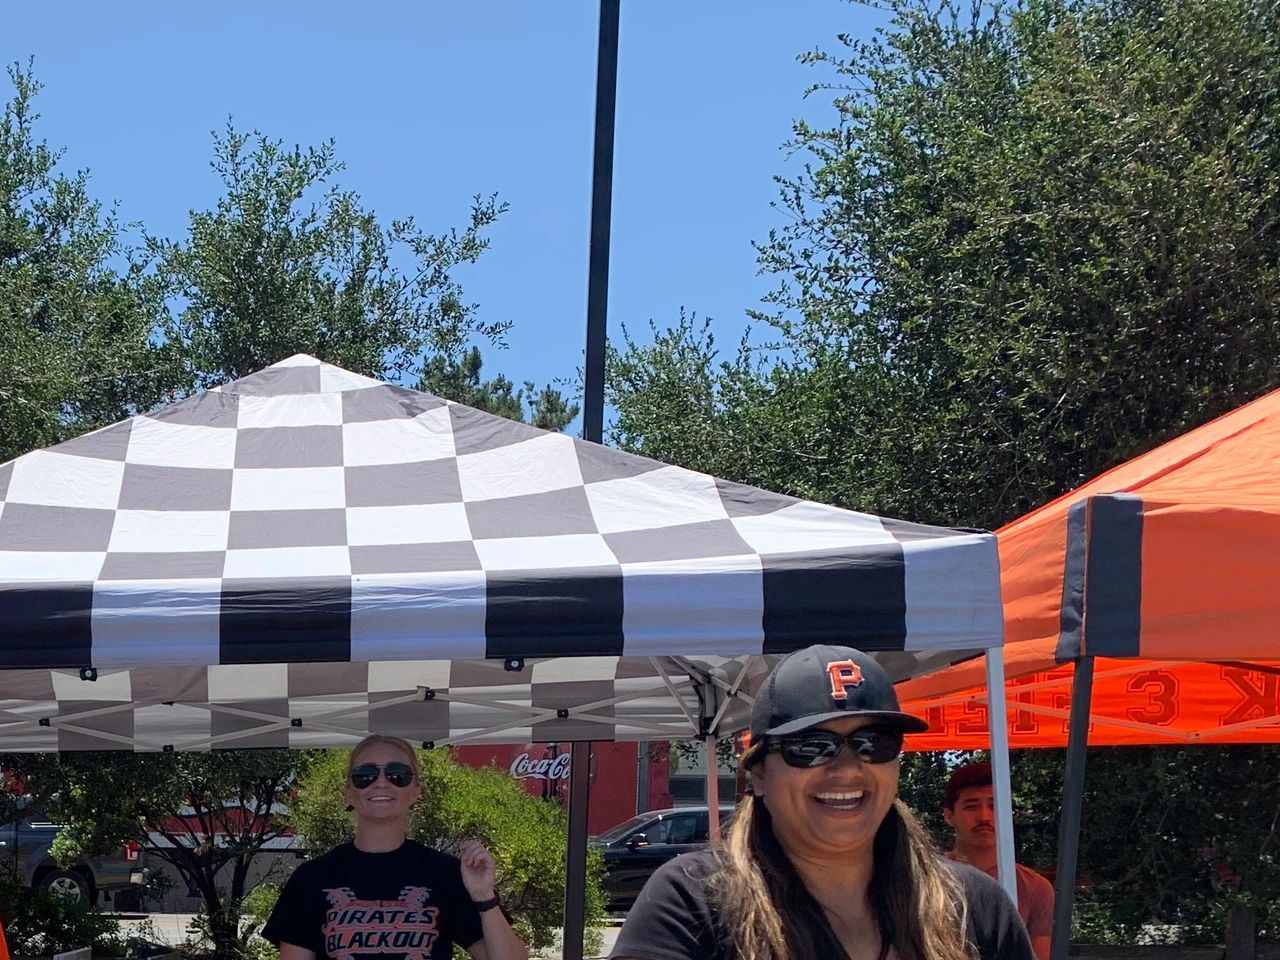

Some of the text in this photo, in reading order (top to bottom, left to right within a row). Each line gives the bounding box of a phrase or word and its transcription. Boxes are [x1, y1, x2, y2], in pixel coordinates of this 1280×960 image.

[826, 658, 866, 700] P
[328, 909, 435, 925] PIRATES
[327, 930, 437, 953] BLACKOUT
